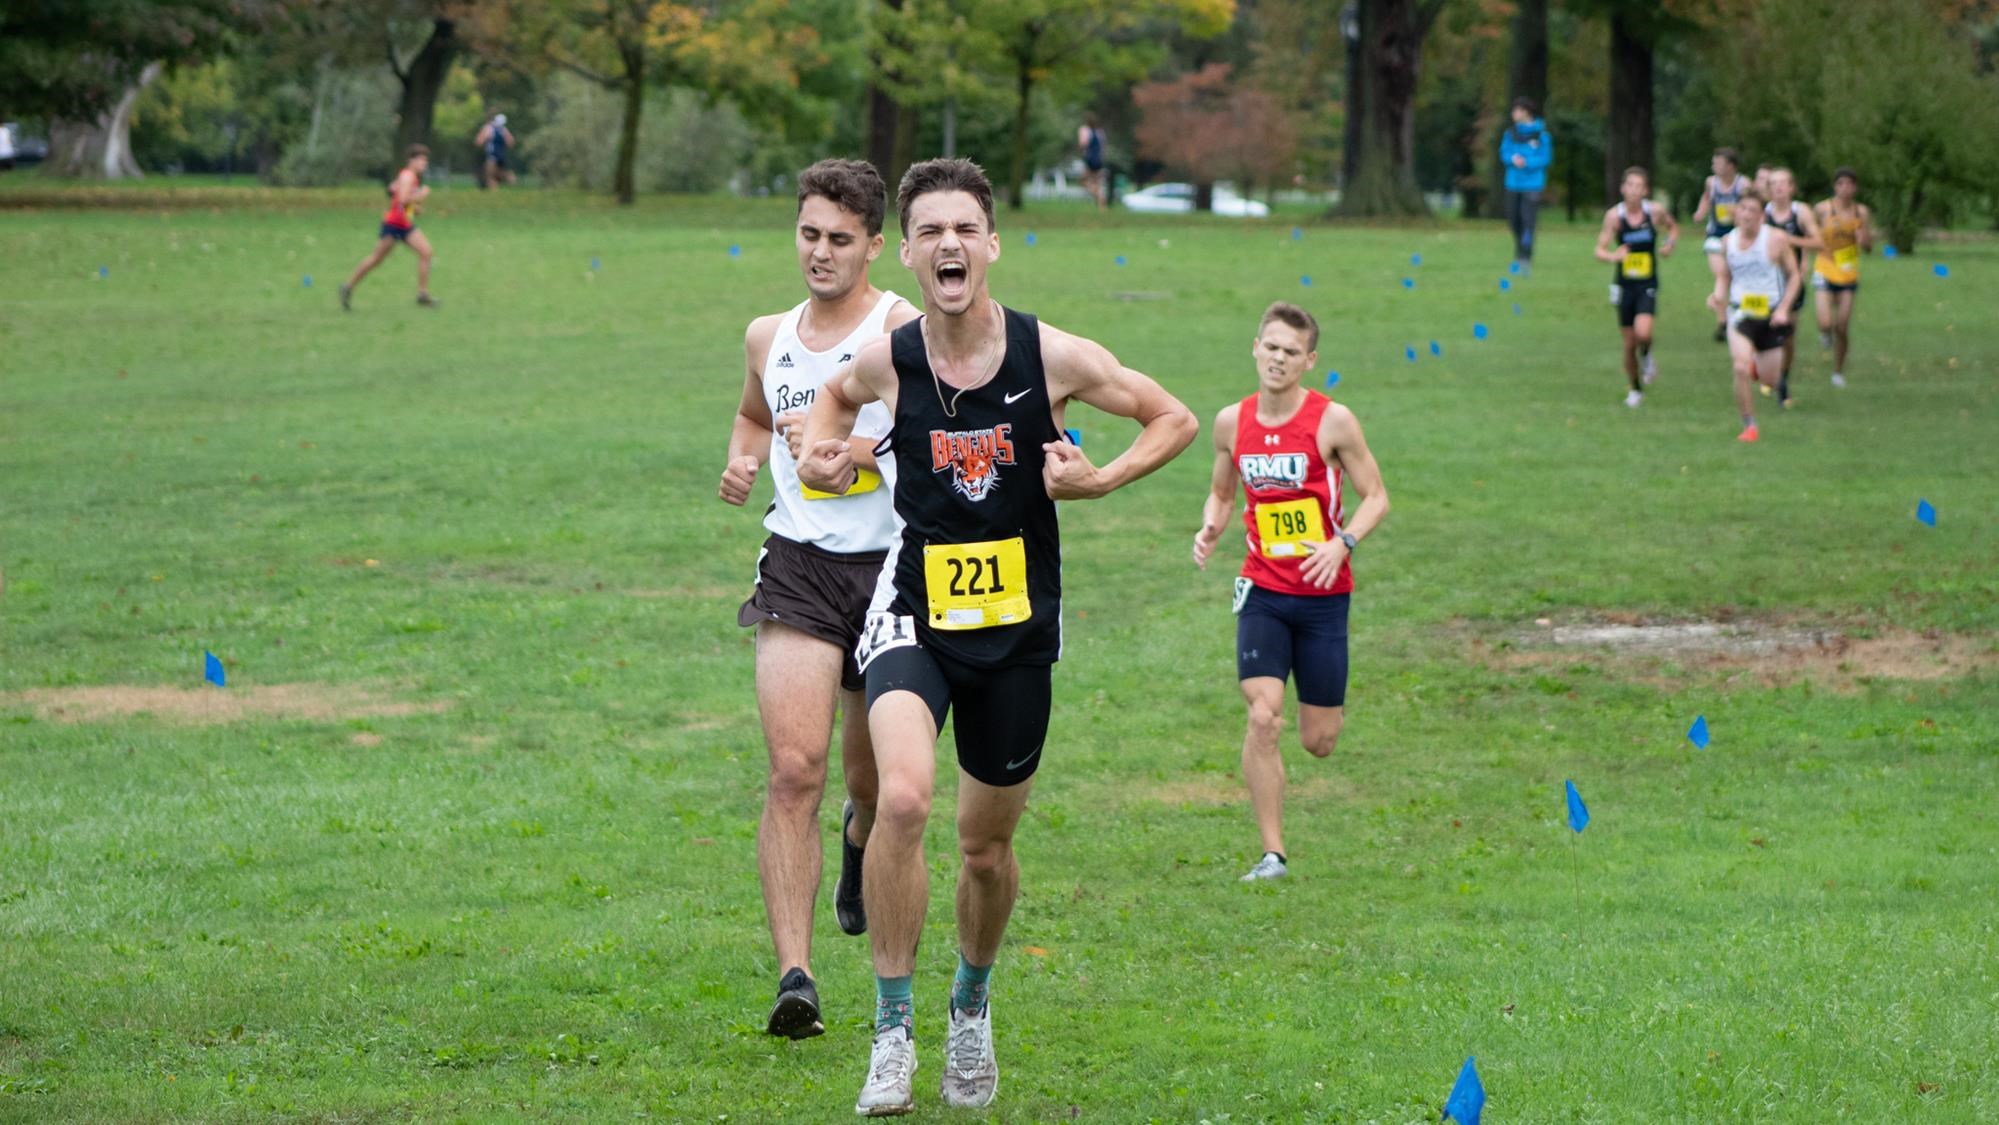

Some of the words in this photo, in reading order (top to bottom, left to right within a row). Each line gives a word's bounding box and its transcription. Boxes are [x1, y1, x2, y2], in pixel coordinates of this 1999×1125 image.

[776, 384, 815, 413] Bon
[929, 423, 1015, 473] BENGALS
[1240, 453, 1308, 484] RMU
[1270, 510, 1307, 536] 798
[947, 555, 1004, 596] 221
